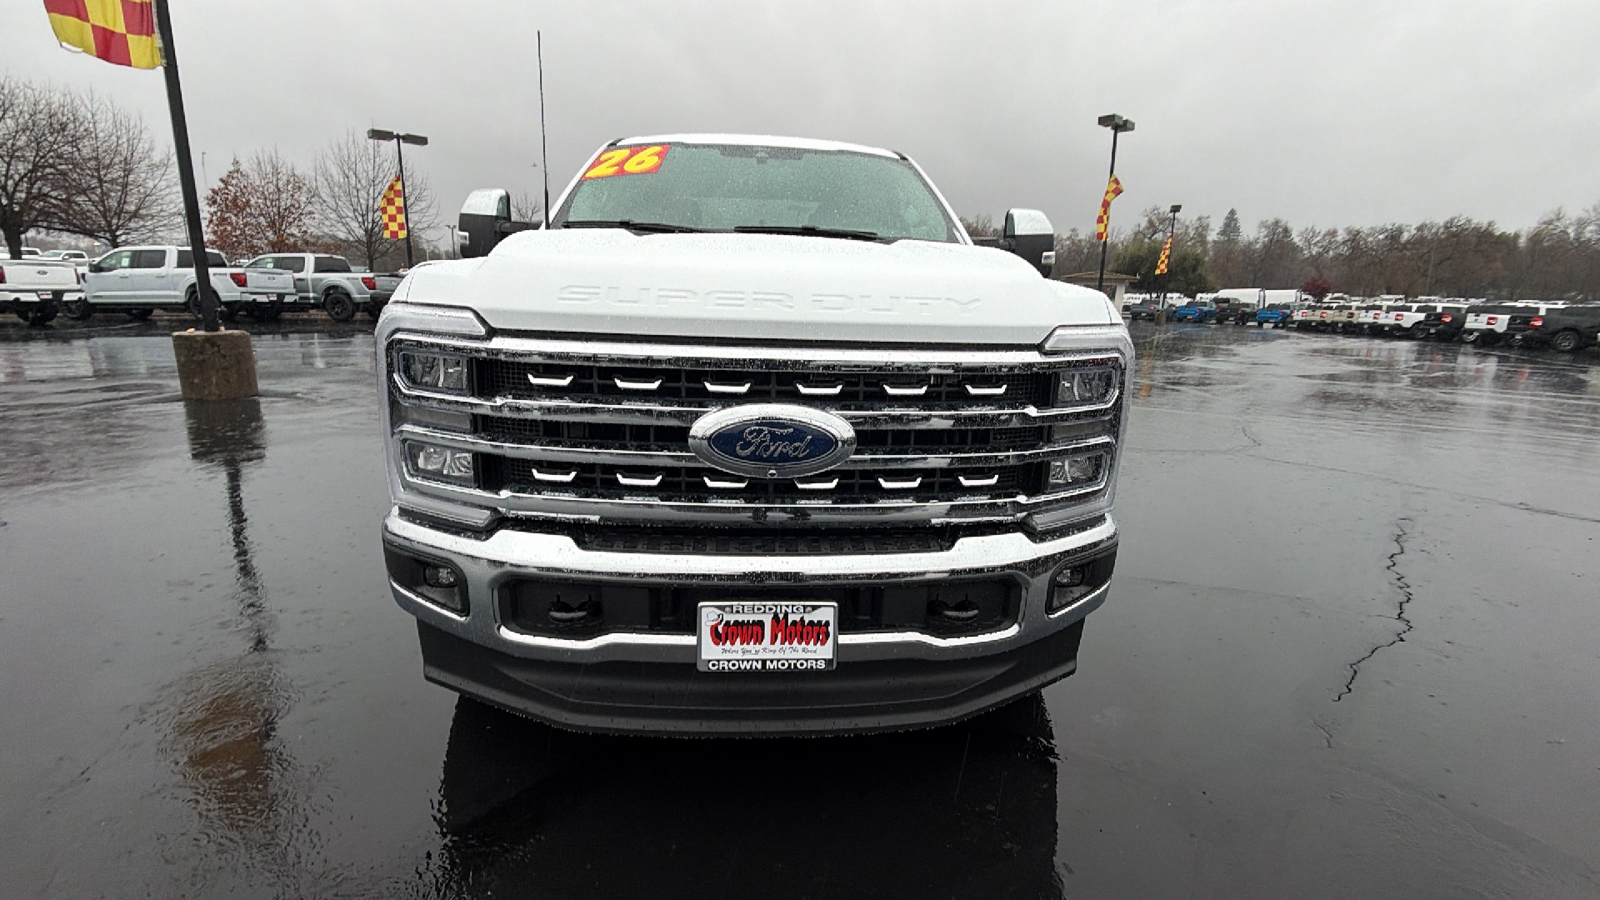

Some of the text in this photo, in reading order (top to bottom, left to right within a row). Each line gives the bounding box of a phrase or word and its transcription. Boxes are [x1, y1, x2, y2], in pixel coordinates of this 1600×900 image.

[584, 146, 663, 178] 26
[557, 285, 982, 316] SUPER DUTY
[736, 426, 813, 458] Ford
[732, 604, 805, 614] REDDING
[709, 613, 831, 646] Crown Motors
[708, 659, 826, 670] CROWN MOTORS
